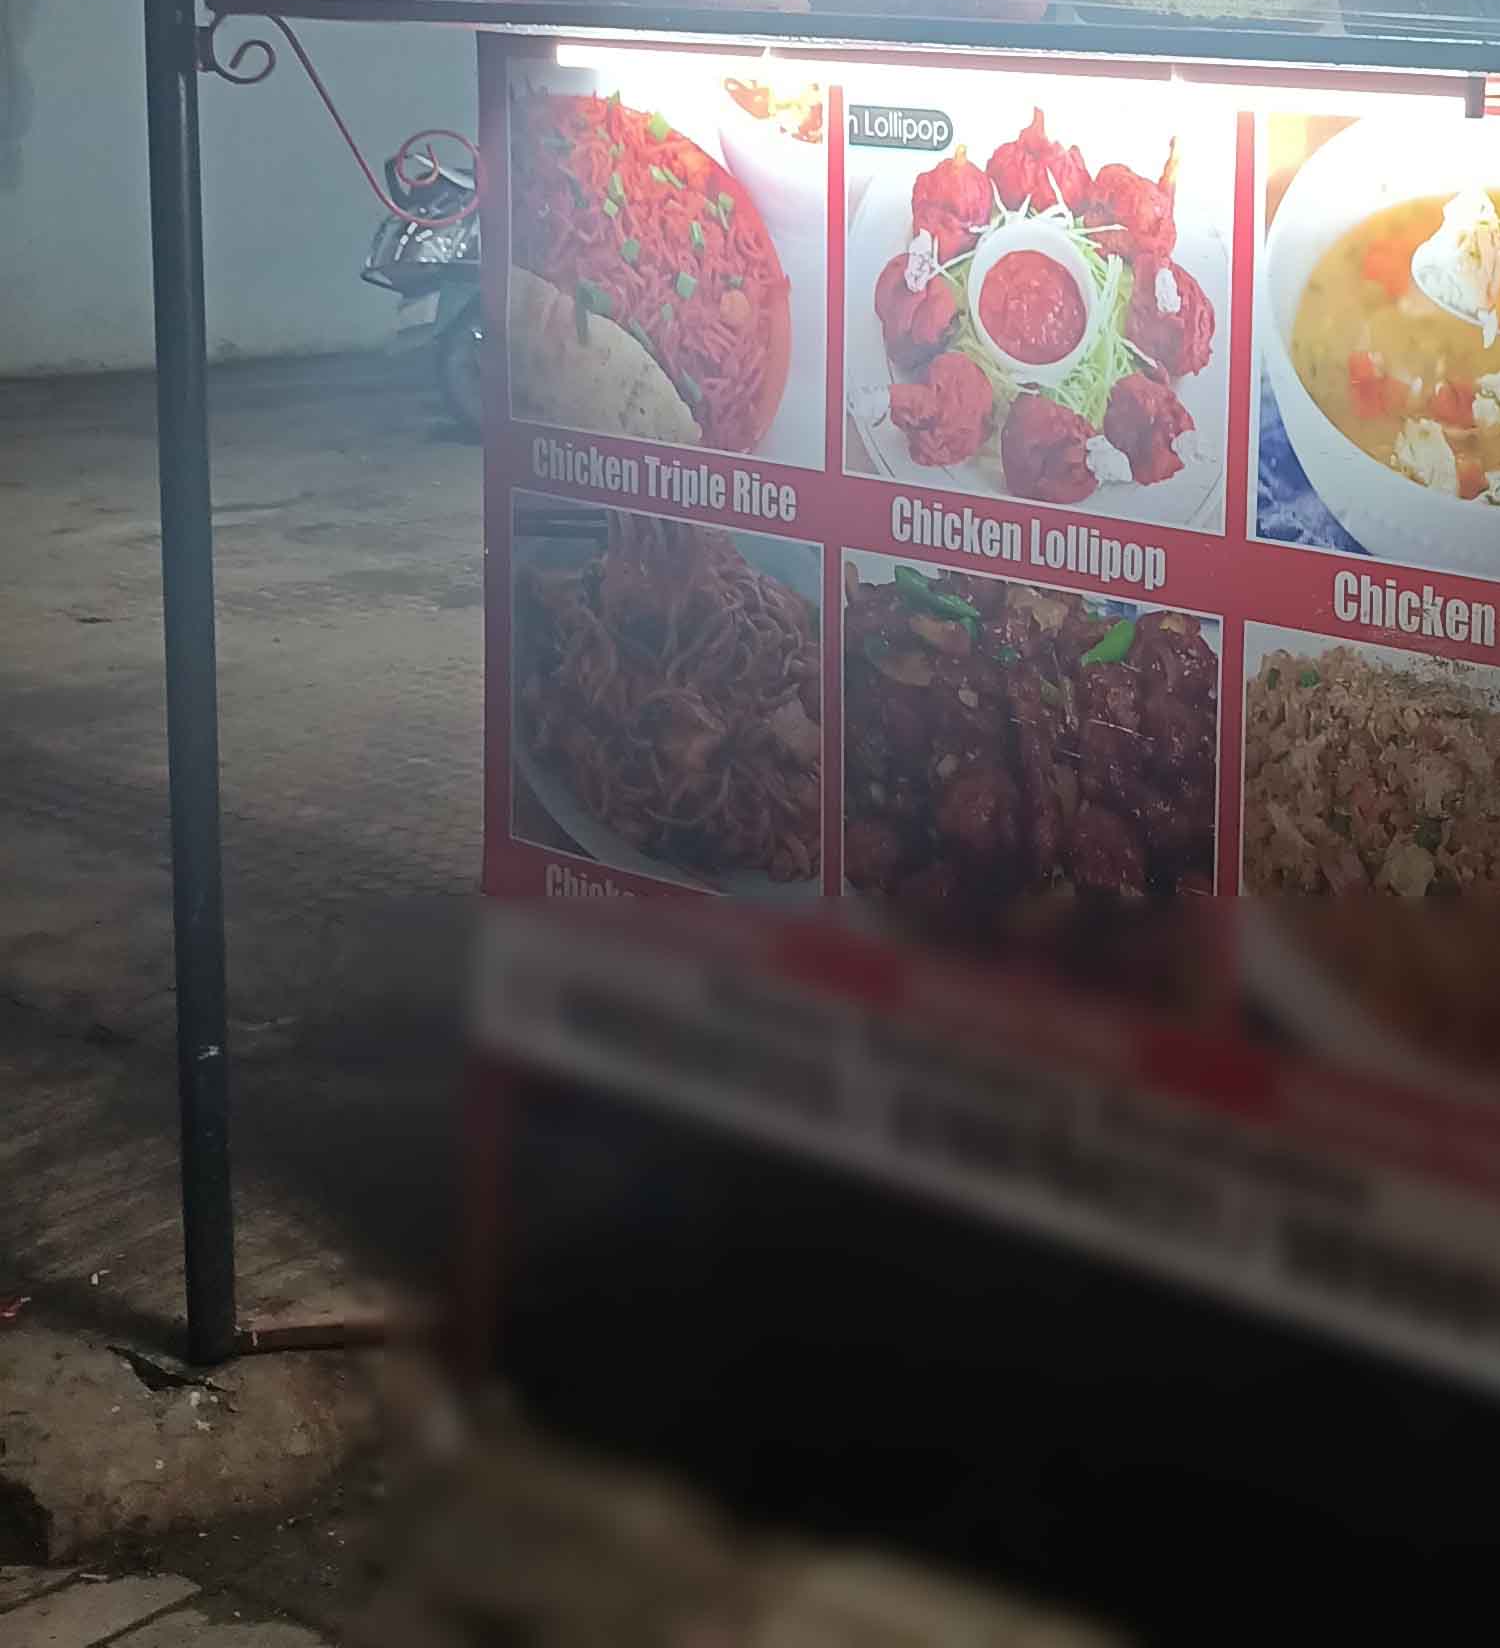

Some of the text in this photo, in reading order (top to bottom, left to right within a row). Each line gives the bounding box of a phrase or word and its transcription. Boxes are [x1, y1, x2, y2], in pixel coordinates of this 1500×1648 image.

[864, 110, 948, 146] Lollipop
[532, 437, 797, 521] Chicken Triple Rice
[891, 495, 1167, 590] Chicken Lollipop
[1333, 570, 1496, 647] Chicken
